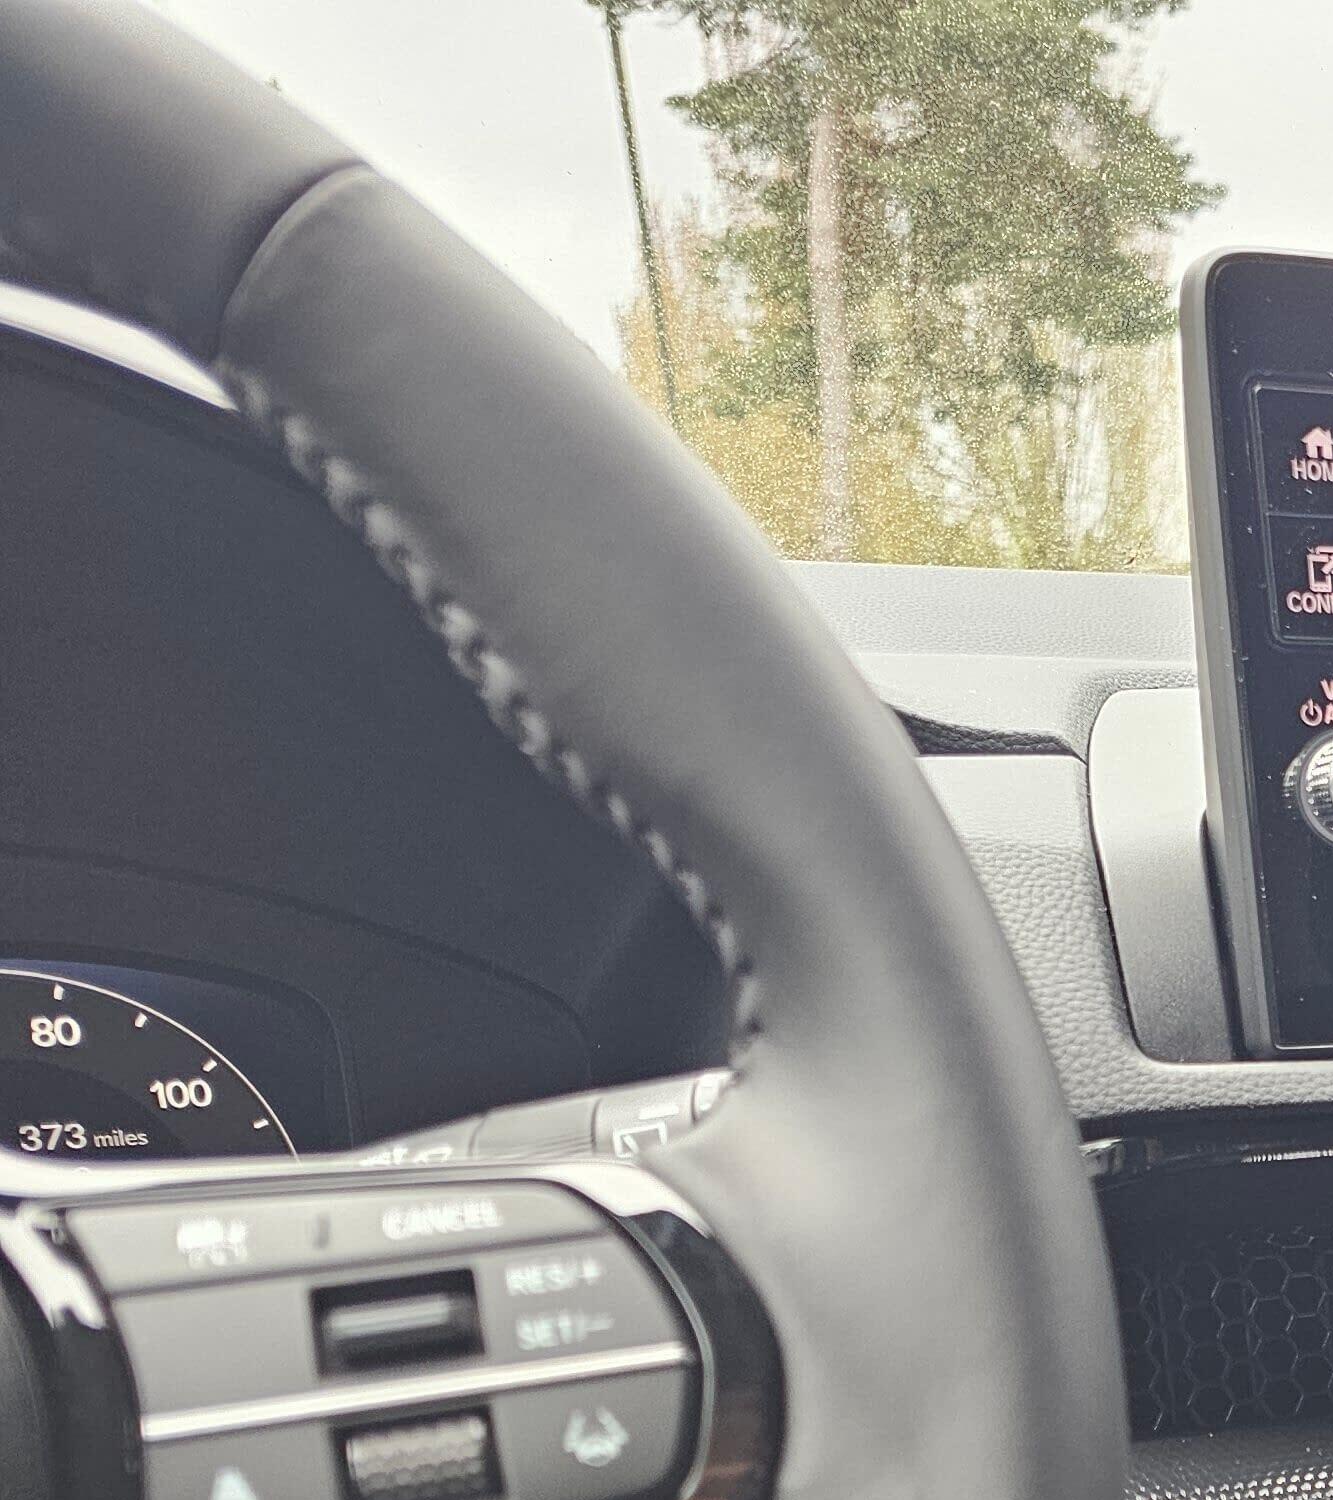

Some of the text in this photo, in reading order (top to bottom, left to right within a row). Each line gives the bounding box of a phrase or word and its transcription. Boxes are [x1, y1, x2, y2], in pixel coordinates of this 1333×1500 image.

[30, 1015, 82, 1048] 80
[149, 1077, 213, 1109] 100
[18, 1122, 149, 1152] 373 miles
